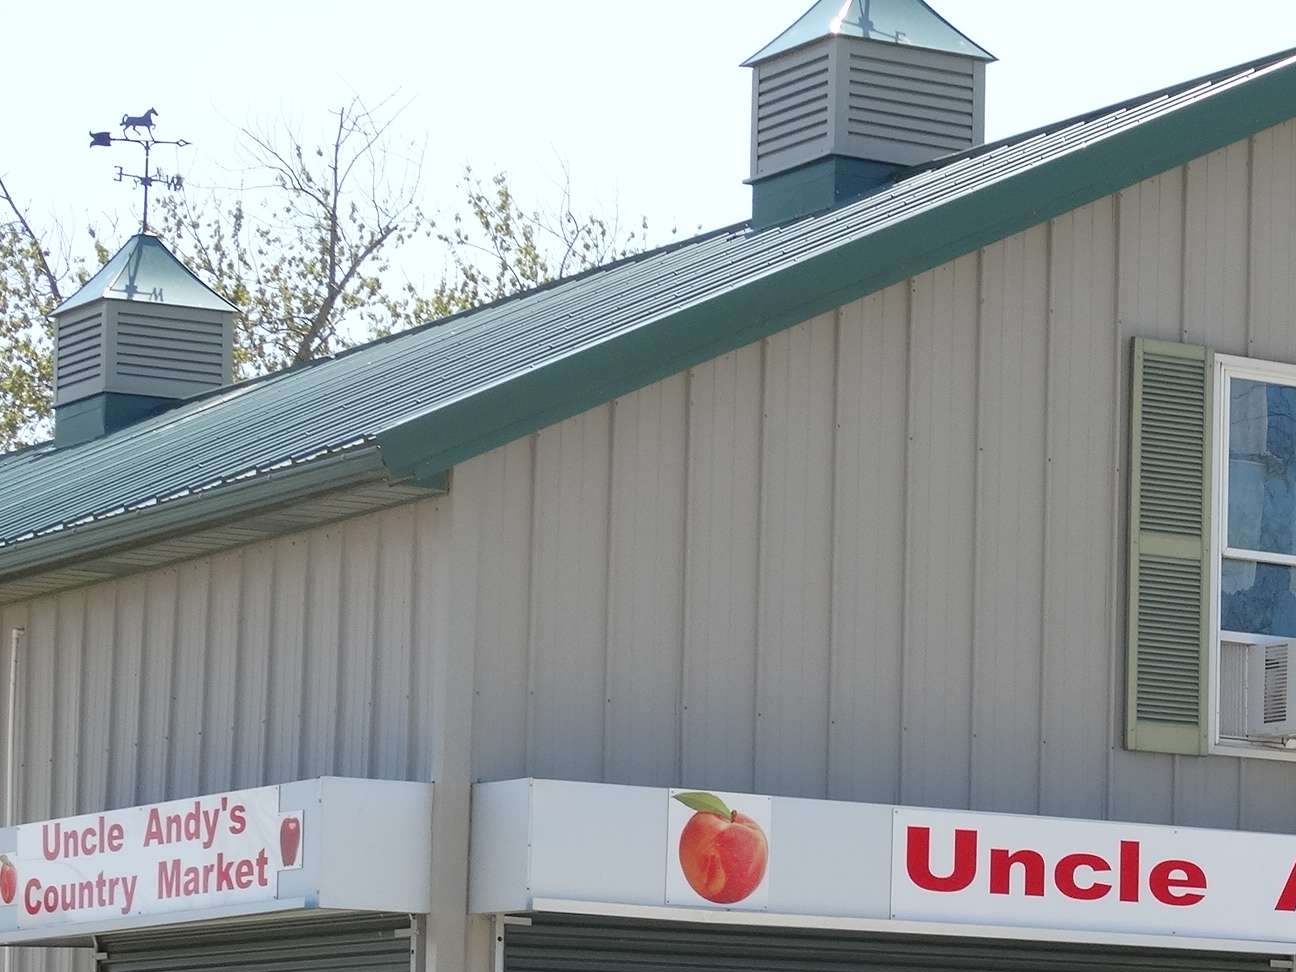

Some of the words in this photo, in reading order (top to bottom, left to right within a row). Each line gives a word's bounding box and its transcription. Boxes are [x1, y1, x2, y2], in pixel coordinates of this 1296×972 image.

[41, 815, 125, 862] Uncle
[143, 796, 247, 850] Andy's
[23, 871, 138, 915] Country
[156, 847, 270, 900] Market
[905, 824, 1209, 908] Uncle
